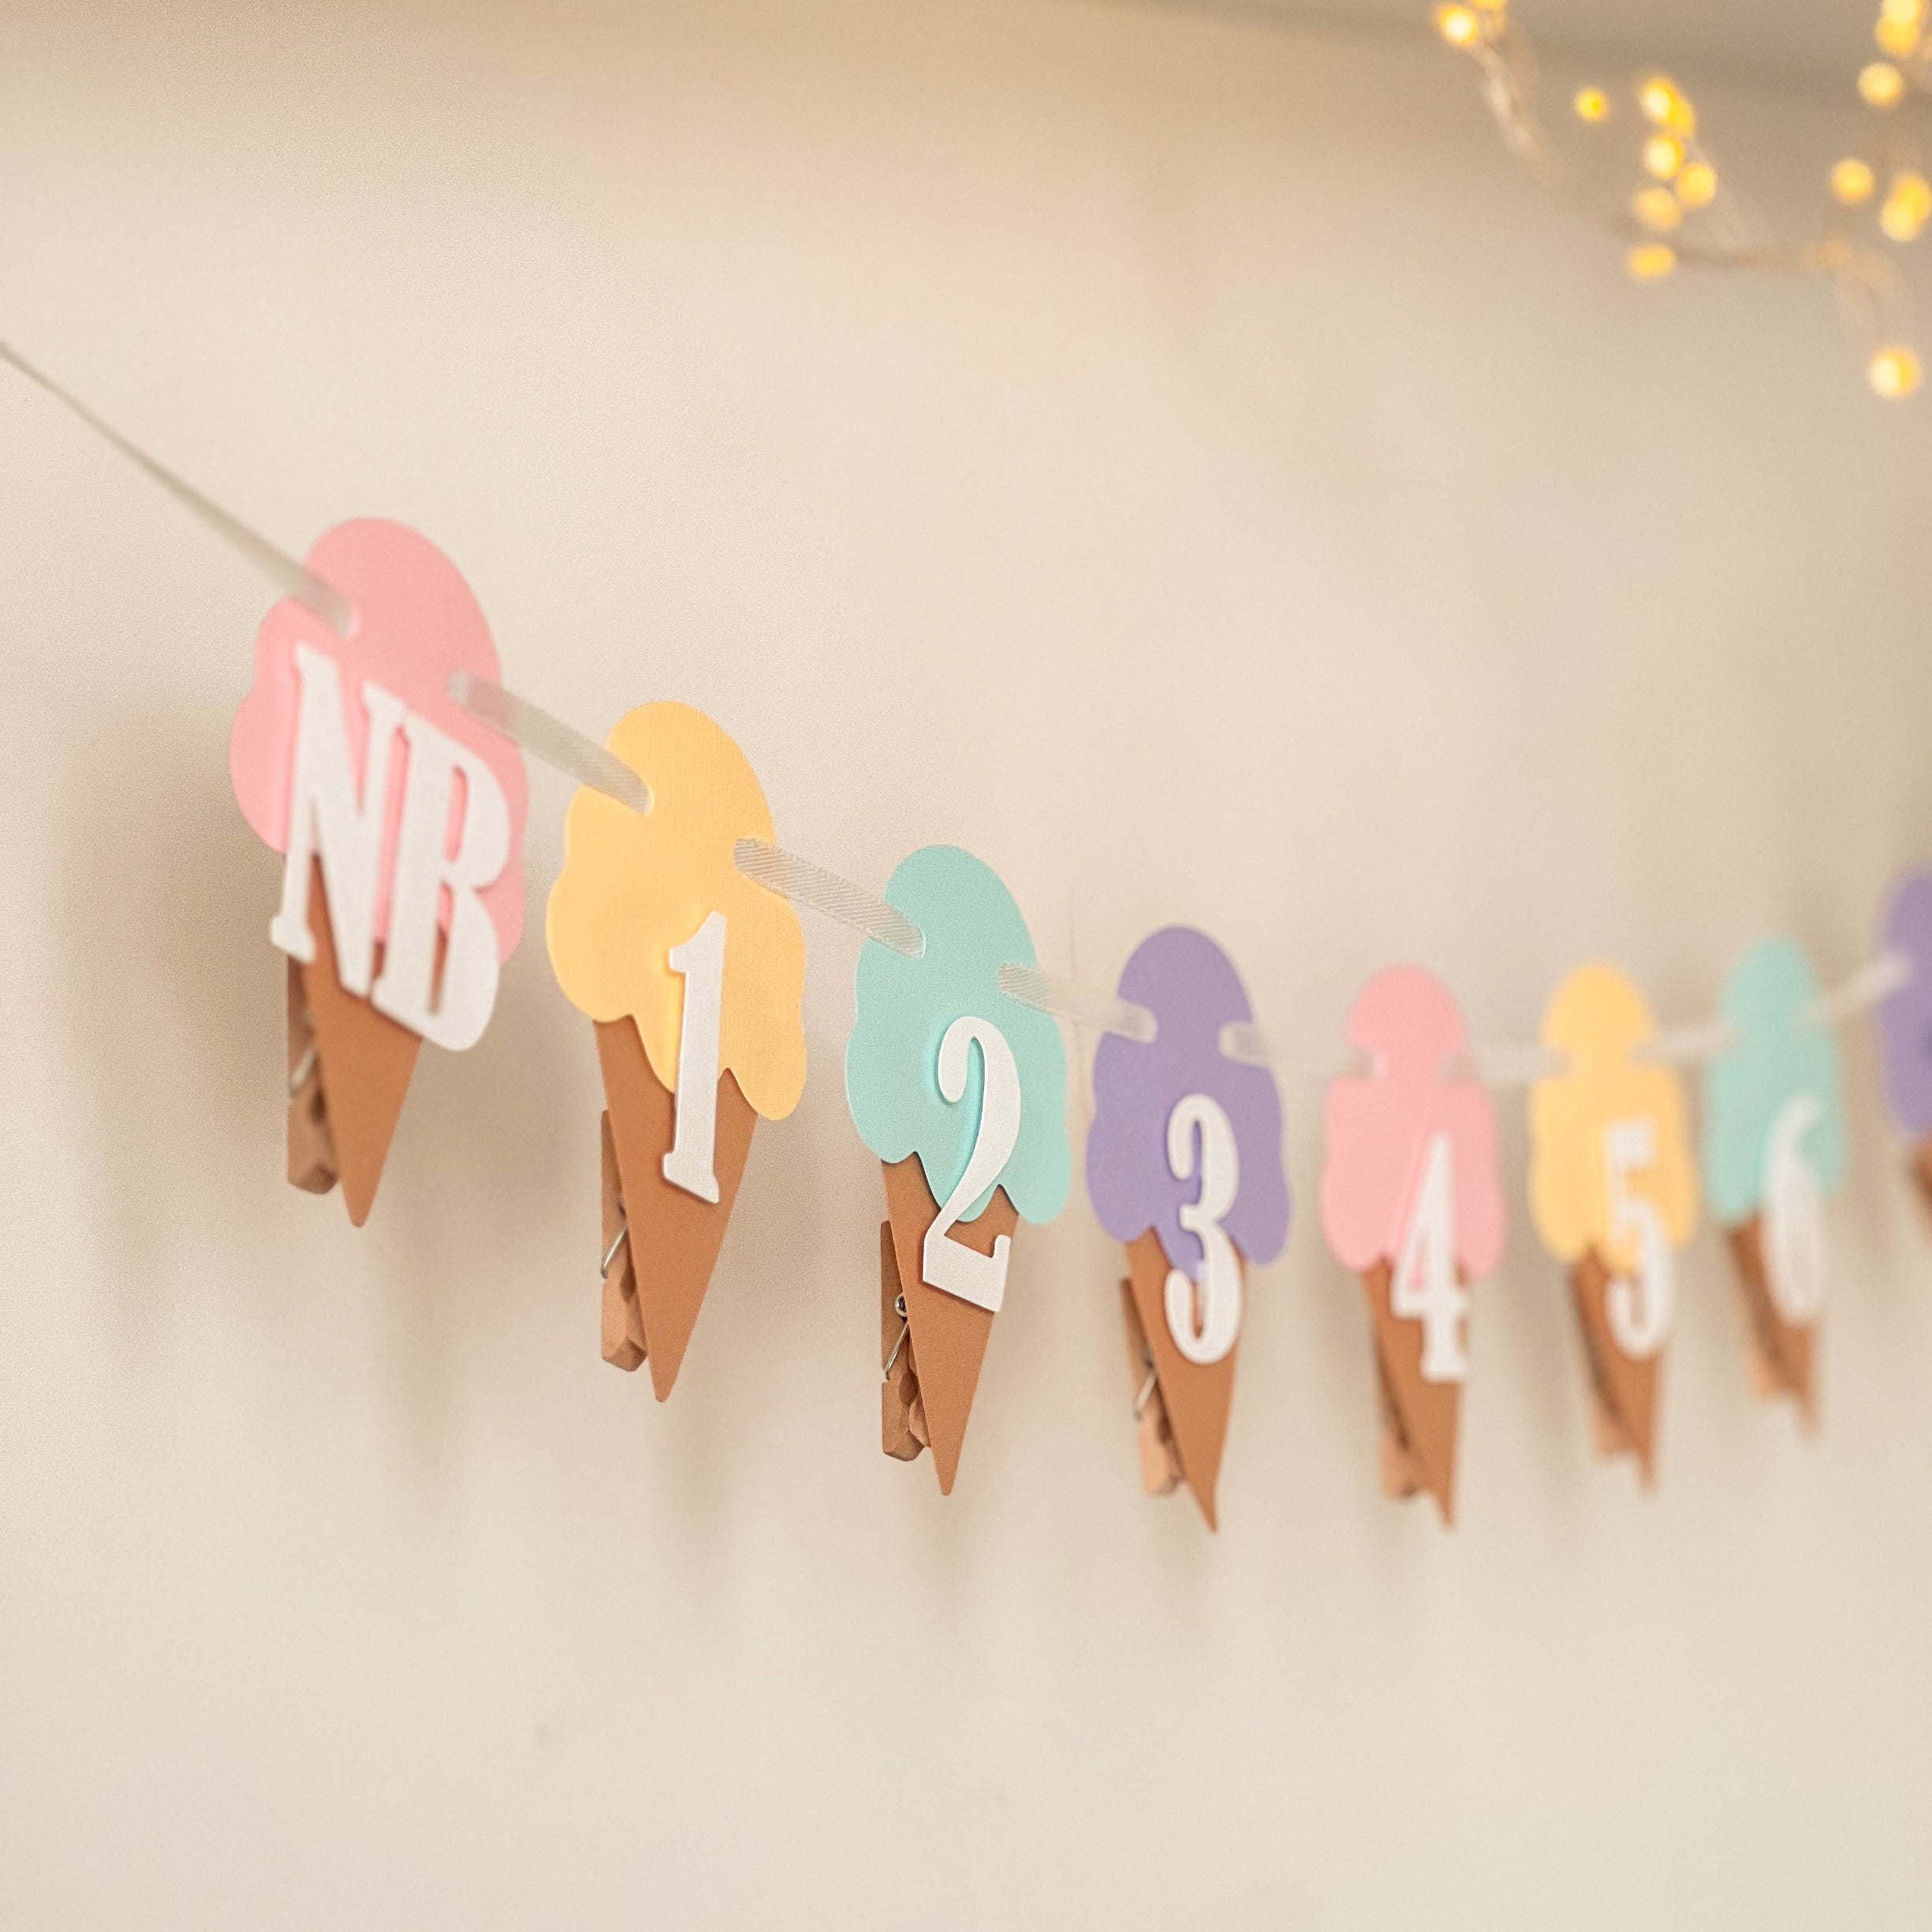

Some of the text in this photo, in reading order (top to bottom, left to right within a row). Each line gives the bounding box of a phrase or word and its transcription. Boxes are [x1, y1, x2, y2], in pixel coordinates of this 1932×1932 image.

[270, 642, 510, 1050] NB
[662, 912, 727, 1203] 1
[923, 1016, 1021, 1312] 2
[1164, 1093, 1240, 1364] 3
[1390, 1131, 1468, 1382] 4
[1601, 1118, 1673, 1359] 5
[1762, 1095, 1823, 1323] 6
